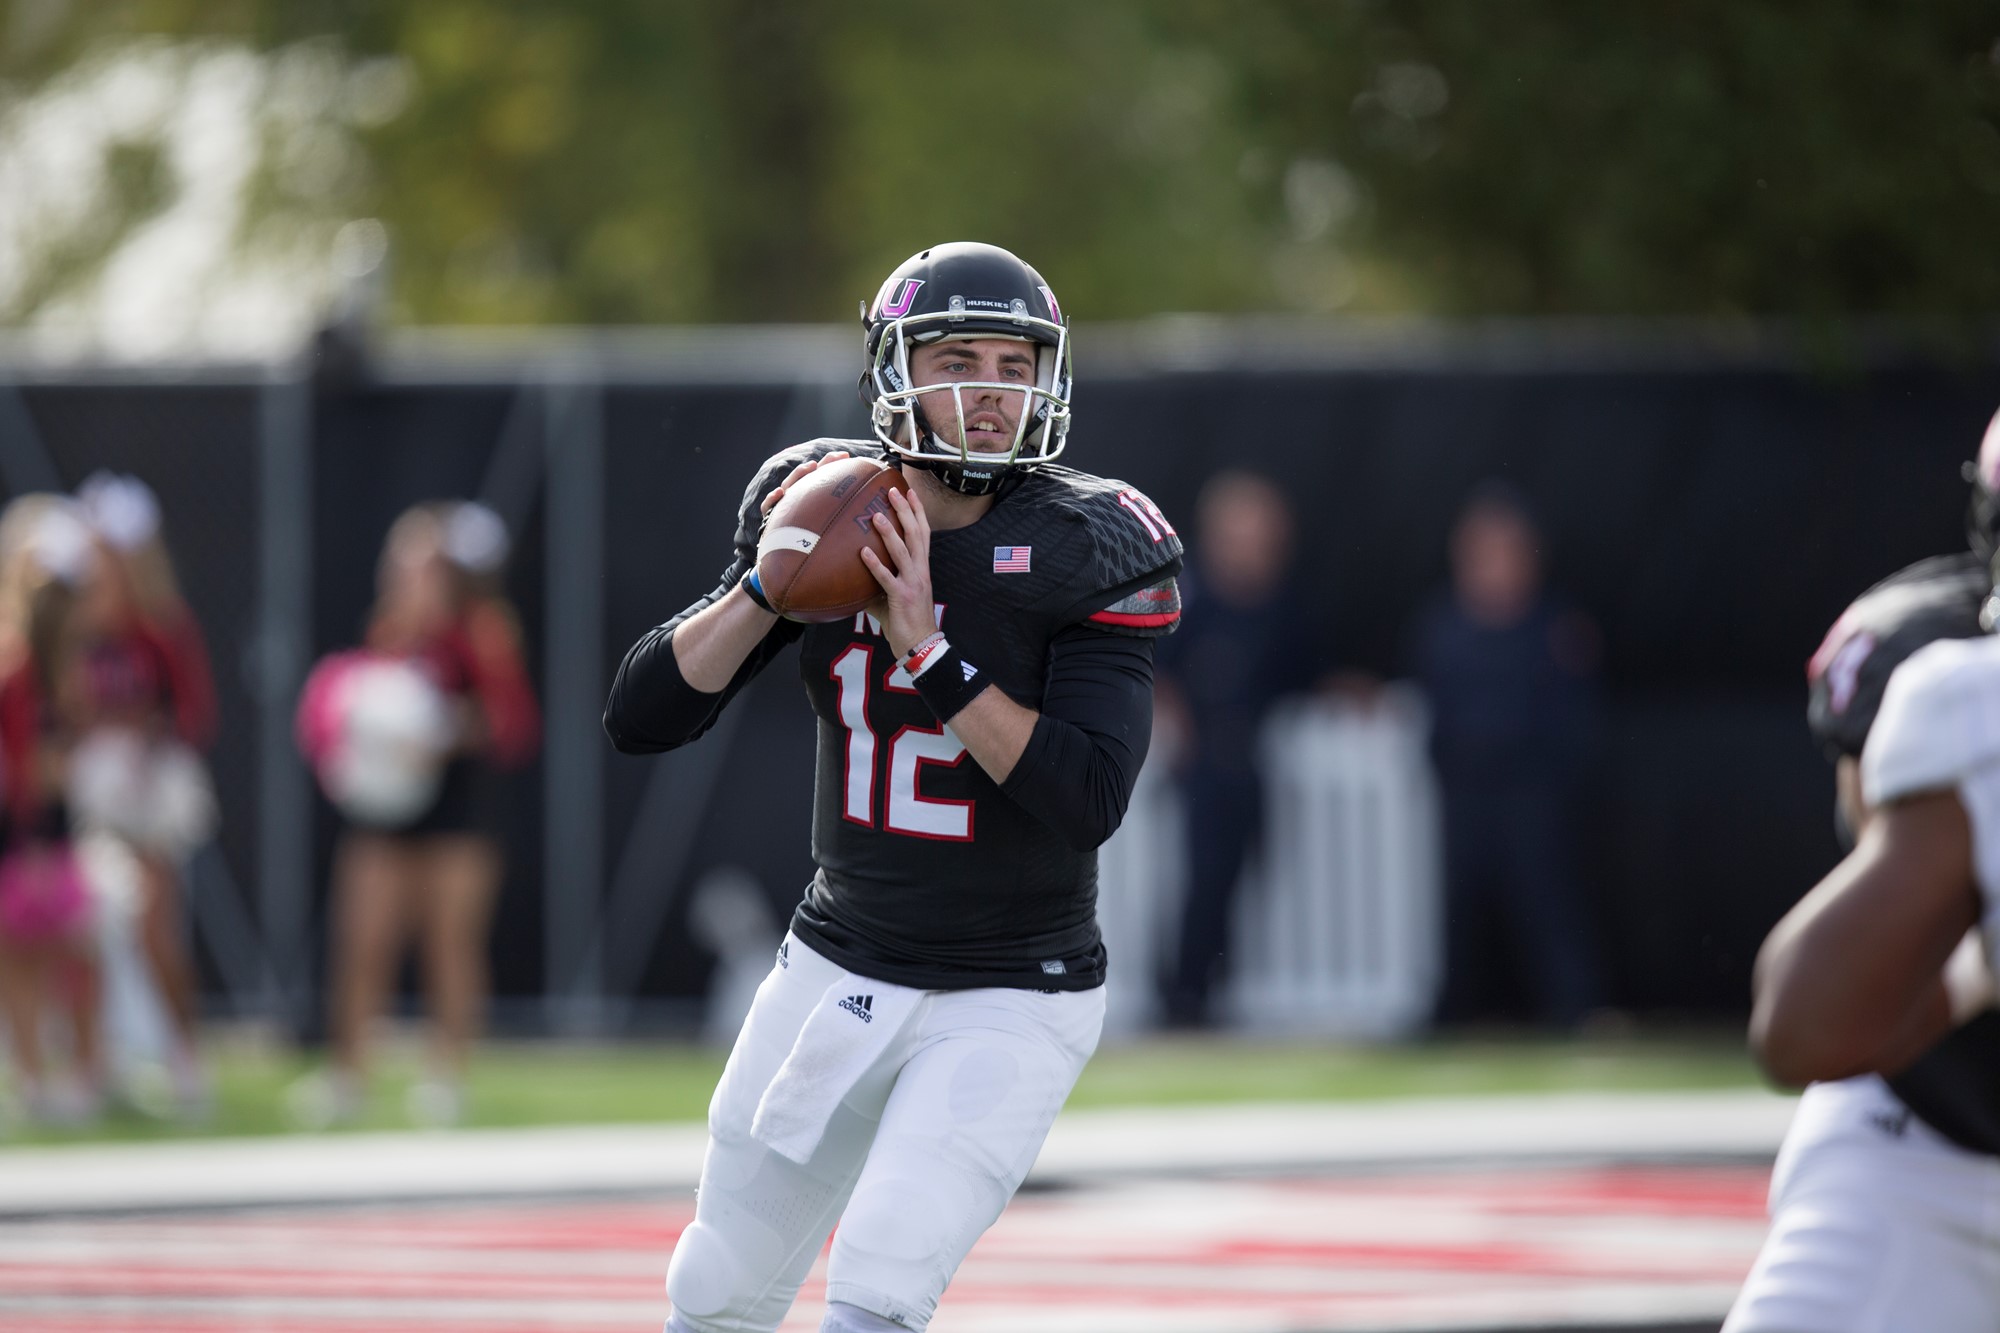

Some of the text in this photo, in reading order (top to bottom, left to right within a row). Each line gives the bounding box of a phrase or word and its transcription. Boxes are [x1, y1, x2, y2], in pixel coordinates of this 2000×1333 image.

[966, 299, 1009, 309] HUSKIES
[962, 469, 993, 480] Riddell
[830, 642, 975, 842] 12
[838, 999, 873, 1024] adidas
